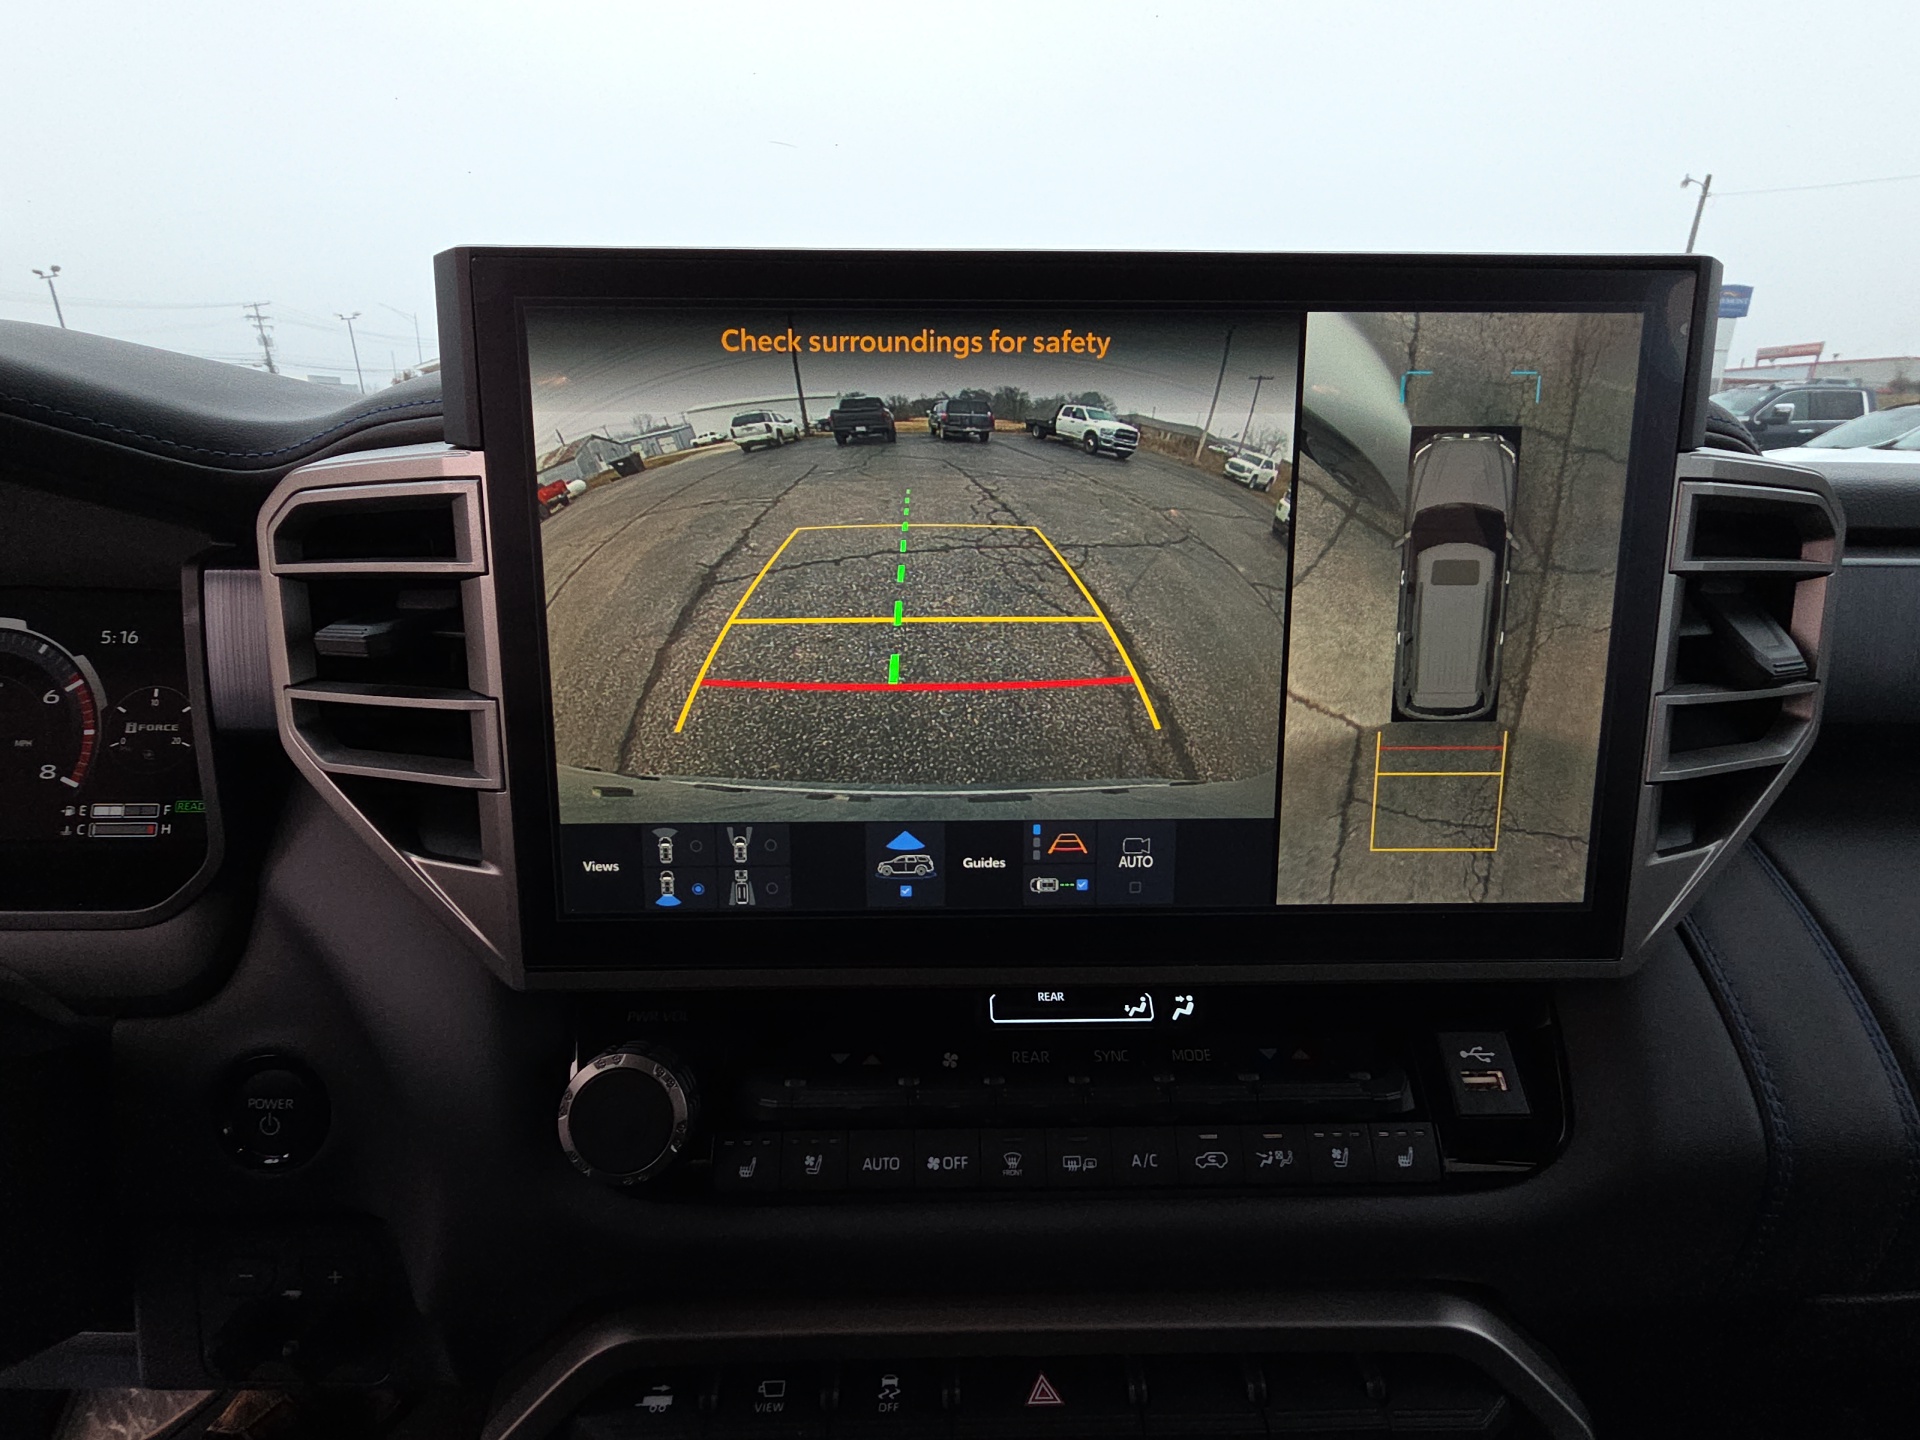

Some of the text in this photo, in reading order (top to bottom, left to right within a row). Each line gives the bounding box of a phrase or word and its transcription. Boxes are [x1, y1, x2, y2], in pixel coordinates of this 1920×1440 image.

[721, 328, 1111, 359] Check surroundings for safety
[100, 630, 139, 645] 5:16
[43, 689, 60, 704] 6
[39, 764, 57, 780] 8
[79, 805, 87, 817] E
[163, 805, 172, 816] F
[76, 824, 85, 835] C
[161, 823, 172, 835] H
[582, 861, 620, 873] Views
[962, 857, 1006, 871] Guides
[1118, 854, 1154, 868] AUTO
[1037, 992, 1065, 1002] REAR
[1011, 1051, 1051, 1064] REAR
[1093, 1049, 1130, 1063] SYNC
[1171, 1048, 1212, 1062] MODE
[248, 1098, 294, 1110] POWER
[862, 1157, 900, 1171] AUTO
[943, 1156, 969, 1170] OFF
[1131, 1152, 1159, 1168] A/C
[754, 1401, 784, 1414] VIEW
[878, 1402, 900, 1413] OFF
